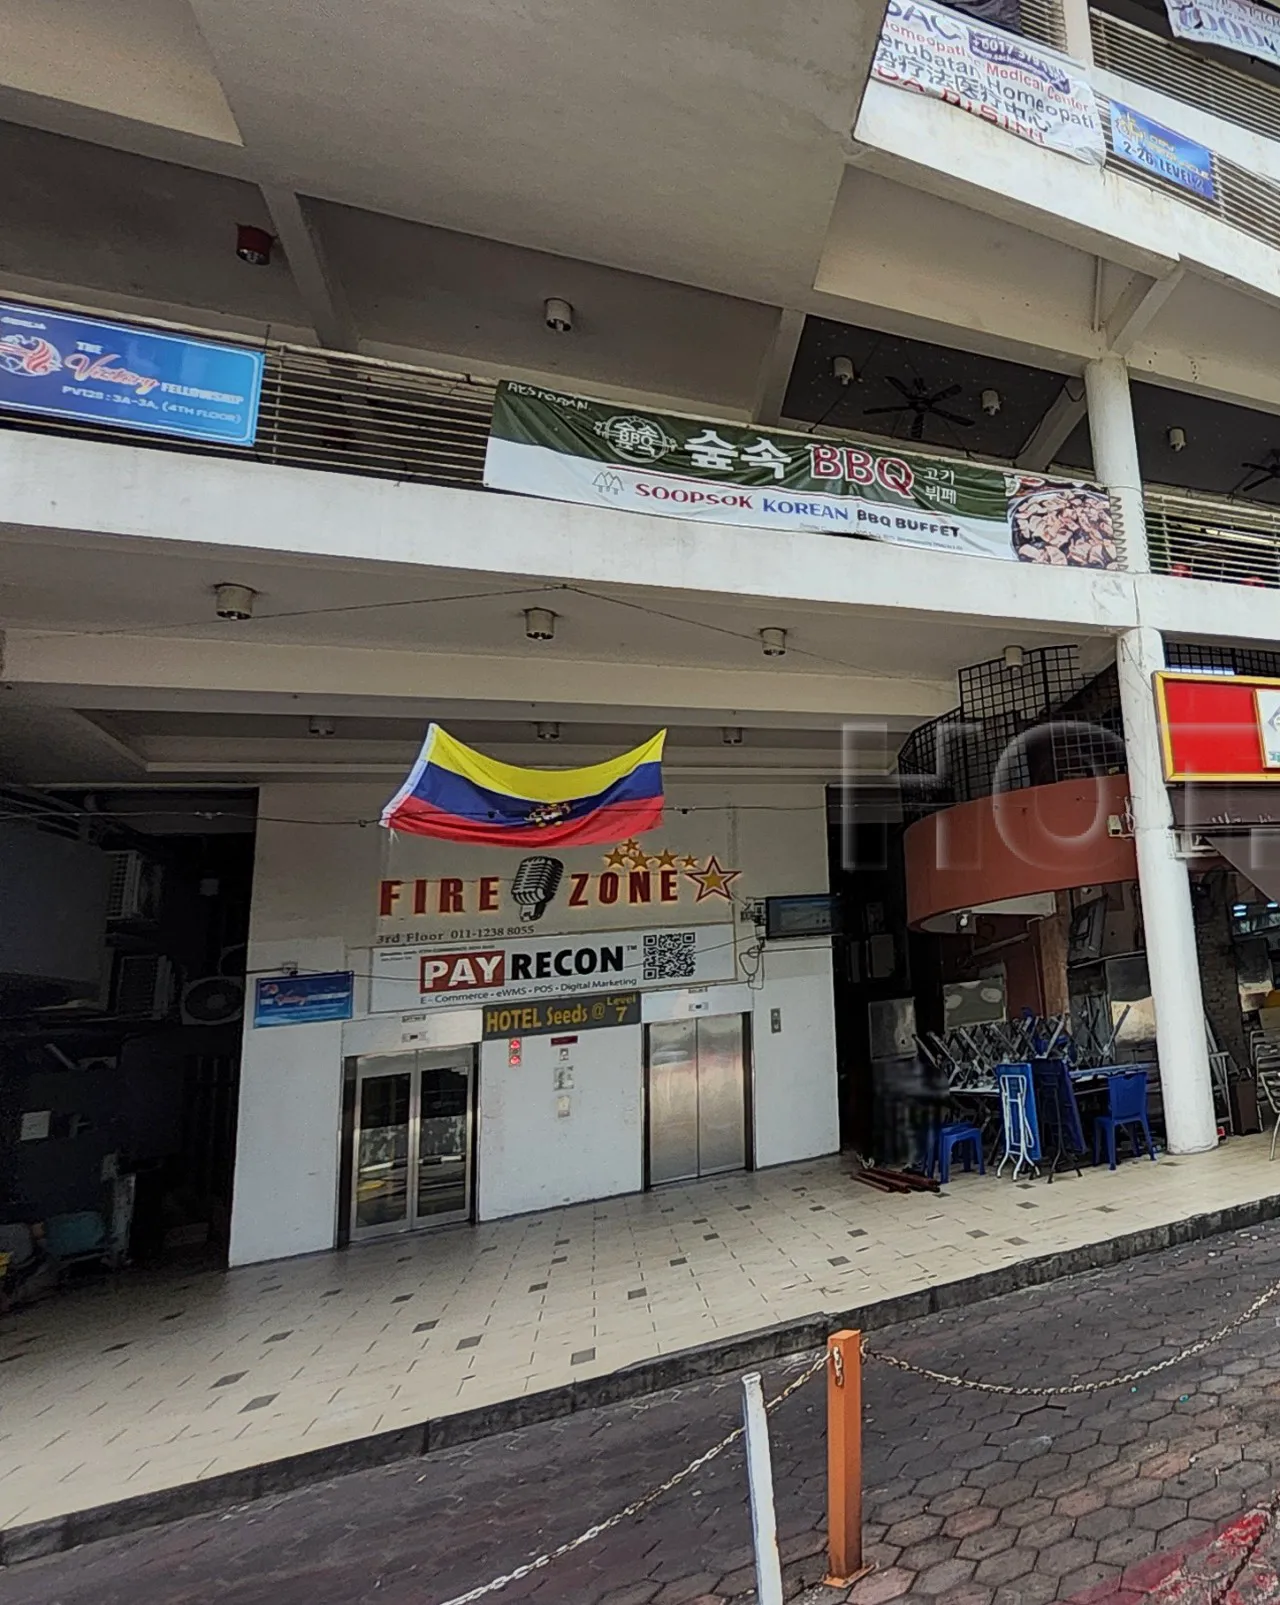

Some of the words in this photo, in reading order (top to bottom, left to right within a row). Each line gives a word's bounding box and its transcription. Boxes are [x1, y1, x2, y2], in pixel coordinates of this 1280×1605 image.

[986, 62, 1043, 92] Medical
[1047, 84, 1089, 113] Center
[986, 76, 1095, 130] Homeopati
[684, 428, 792, 480] 숲속
[807, 443, 916, 500] BBQ
[923, 467, 956, 486] 고기
[634, 482, 753, 510] SOOPSOK
[762, 497, 849, 522] KOREAN
[856, 508, 893, 529] BBQ
[895, 517, 960, 538] BUFFET
[379, 876, 501, 917] FIRE
[568, 869, 679, 908] ZONE
[406, 931, 444, 943] Floor
[450, 928, 505, 939] 011-1238
[506, 925, 535, 935] 8055
[424, 955, 503, 989] PAY
[511, 945, 624, 981] RECON
[434, 991, 489, 1004] Commerce
[495, 987, 527, 998] eWMS
[534, 984, 554, 994] POS
[560, 980, 591, 993] Digital
[592, 977, 637, 989] Marketing
[486, 1007, 542, 1033] HOTEL
[546, 1003, 588, 1026] Seeds
[591, 1002, 606, 1020] @
[615, 1006, 628, 1023] 7
